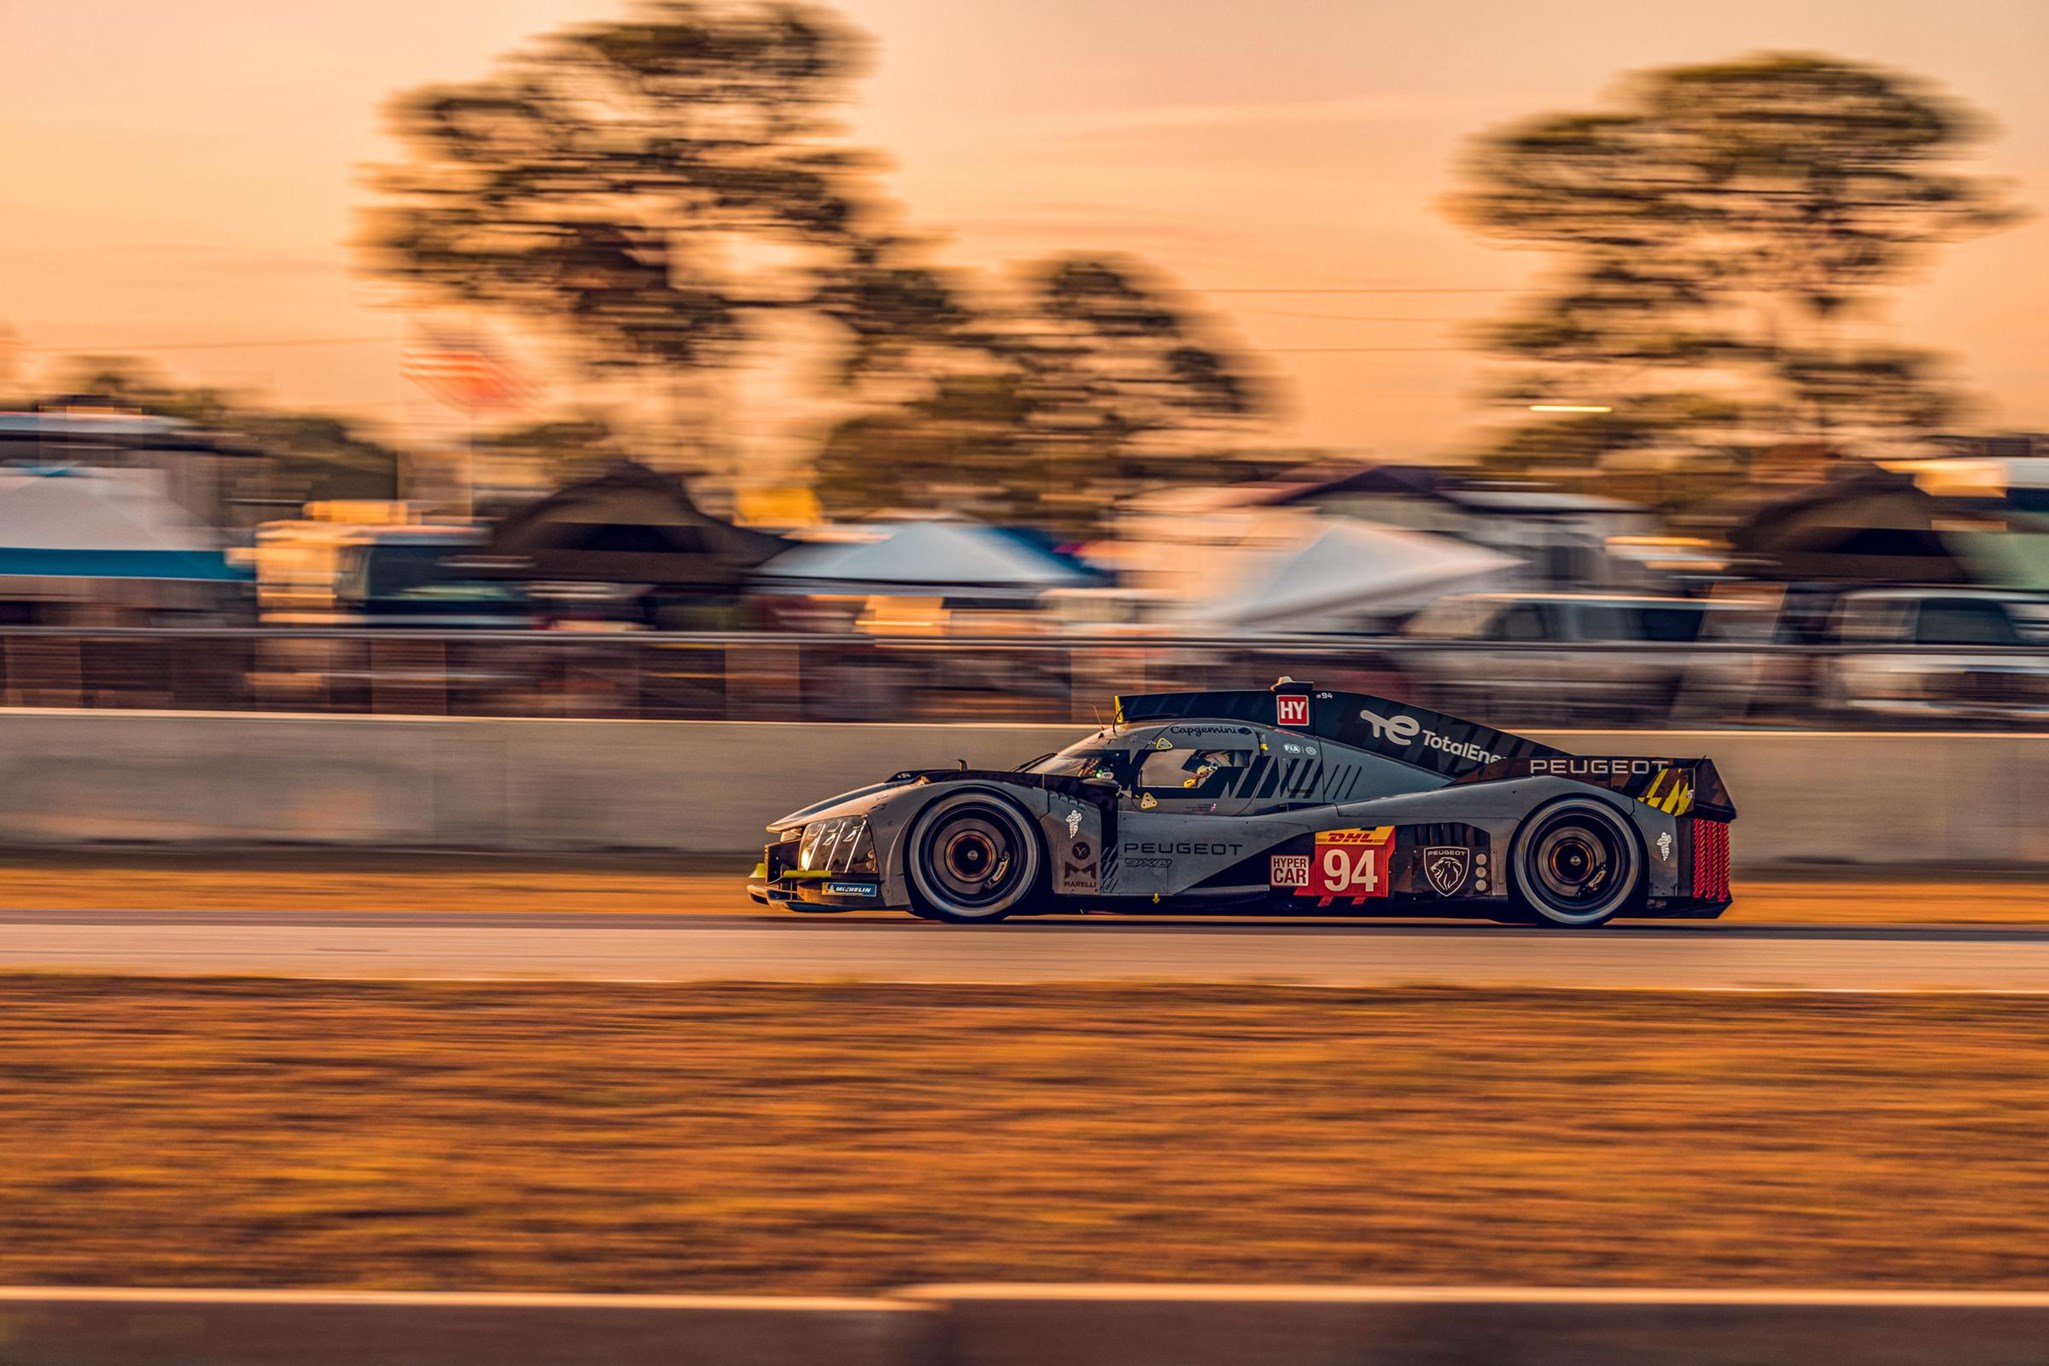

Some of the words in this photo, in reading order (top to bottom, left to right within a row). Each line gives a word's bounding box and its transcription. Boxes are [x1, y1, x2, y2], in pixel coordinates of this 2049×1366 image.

[1280, 701, 1306, 720] HY
[1170, 726, 1238, 737] Capgemini
[1422, 730, 1507, 765] TotalEne
[1530, 759, 1669, 774] PEUGEOT
[1328, 832, 1374, 843] DHL
[1124, 843, 1243, 856] PEUGEOT
[1273, 857, 1307, 868] HYPER
[1323, 848, 1379, 892] 94
[1273, 868, 1307, 884] CAR
